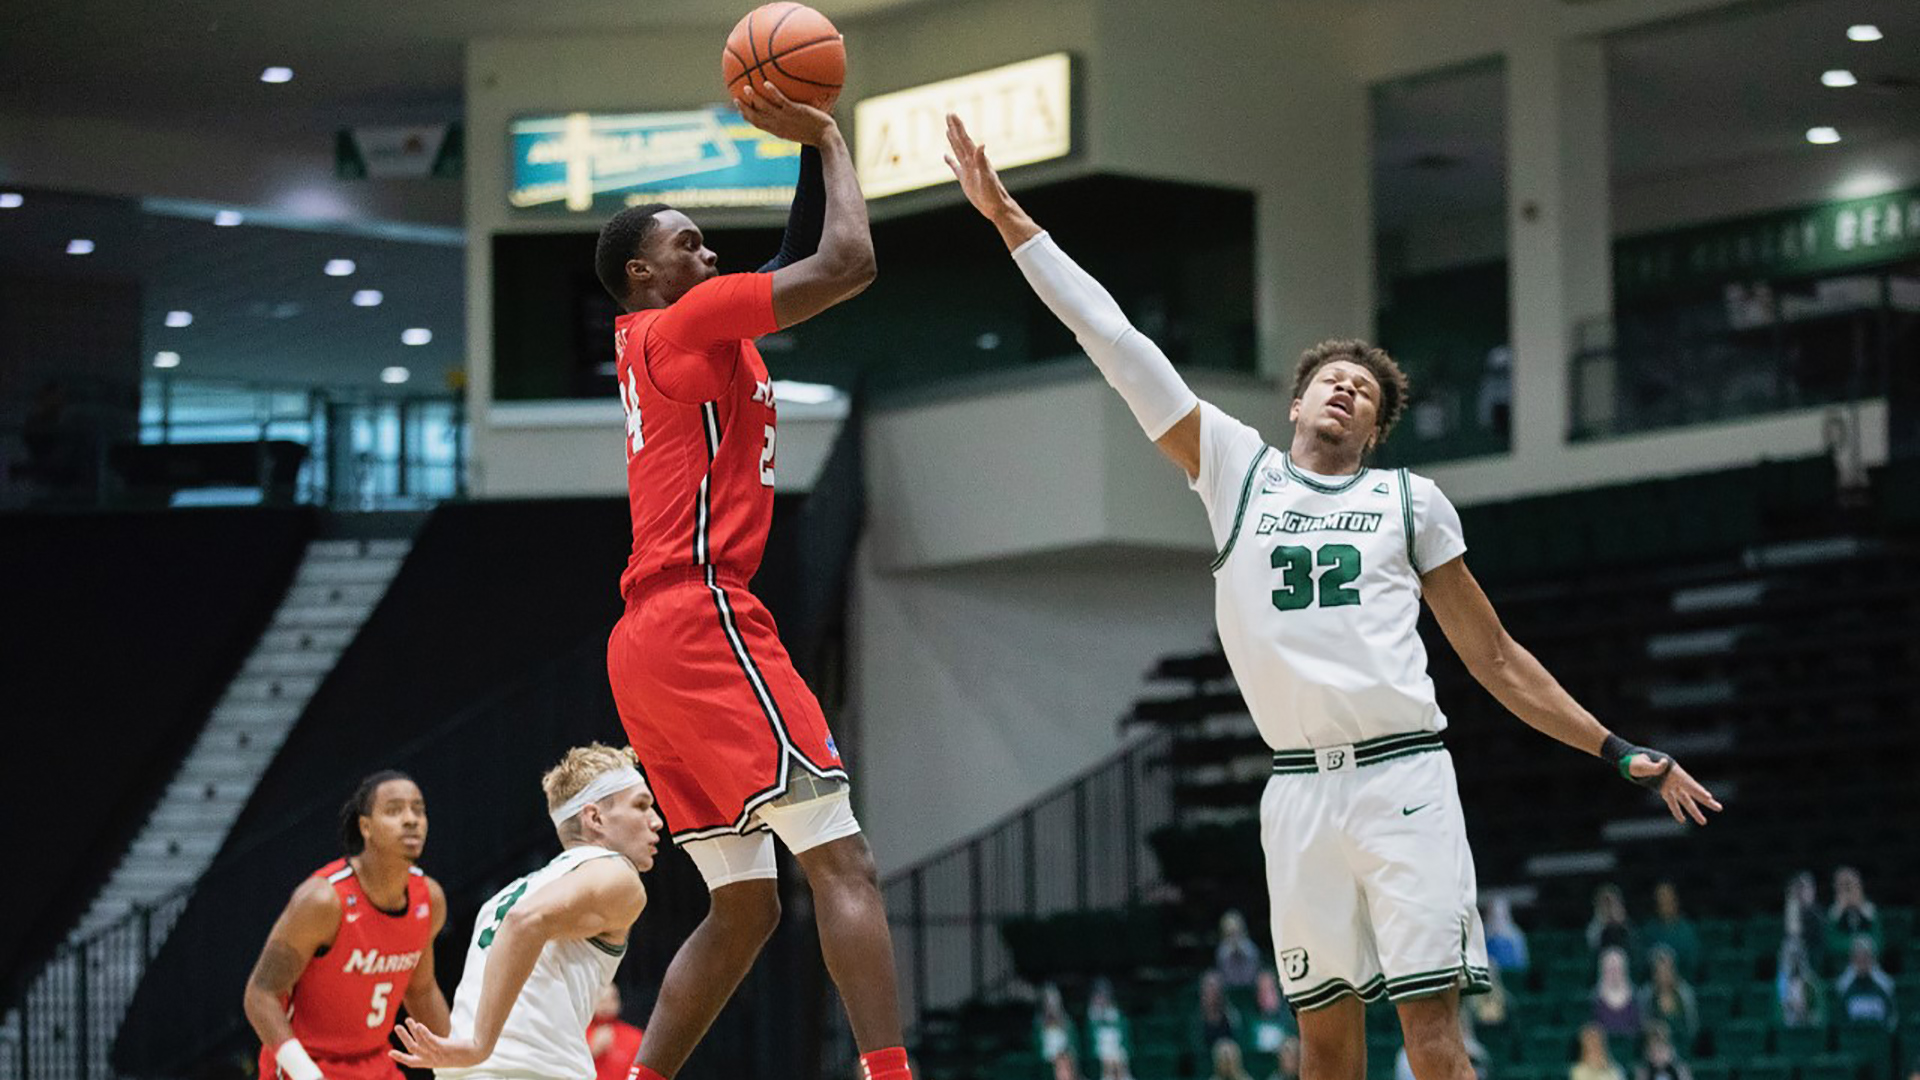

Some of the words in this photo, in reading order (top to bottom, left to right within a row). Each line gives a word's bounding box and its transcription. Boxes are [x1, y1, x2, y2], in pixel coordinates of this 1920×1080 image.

[1271, 543, 1362, 612] 32
[1327, 750, 1345, 770] B
[1281, 947, 1309, 981] B
[366, 981, 394, 1029] 5
